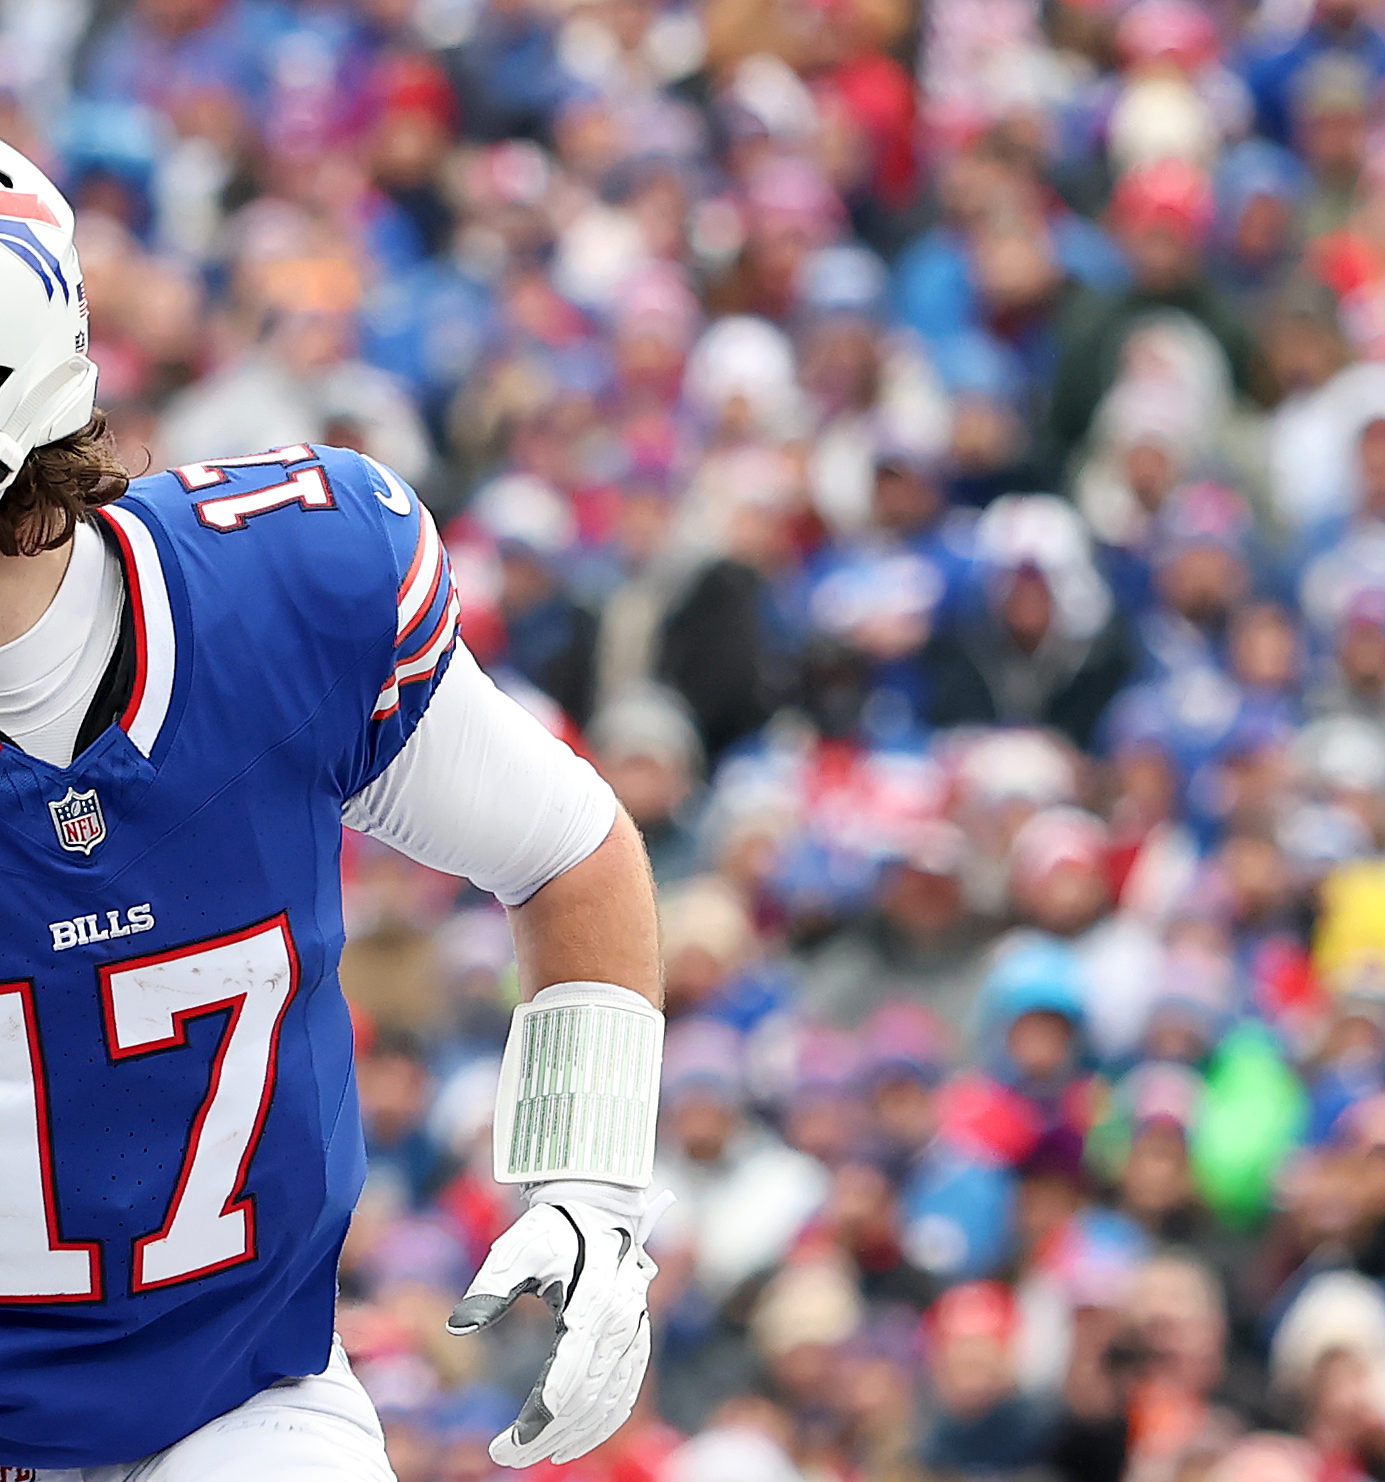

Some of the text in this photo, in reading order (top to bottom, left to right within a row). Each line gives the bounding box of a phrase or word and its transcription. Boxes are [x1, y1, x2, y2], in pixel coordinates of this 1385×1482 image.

[167, 442, 338, 534] 17
[61, 814, 99, 844] NFL
[48, 902, 156, 952] BILLS
